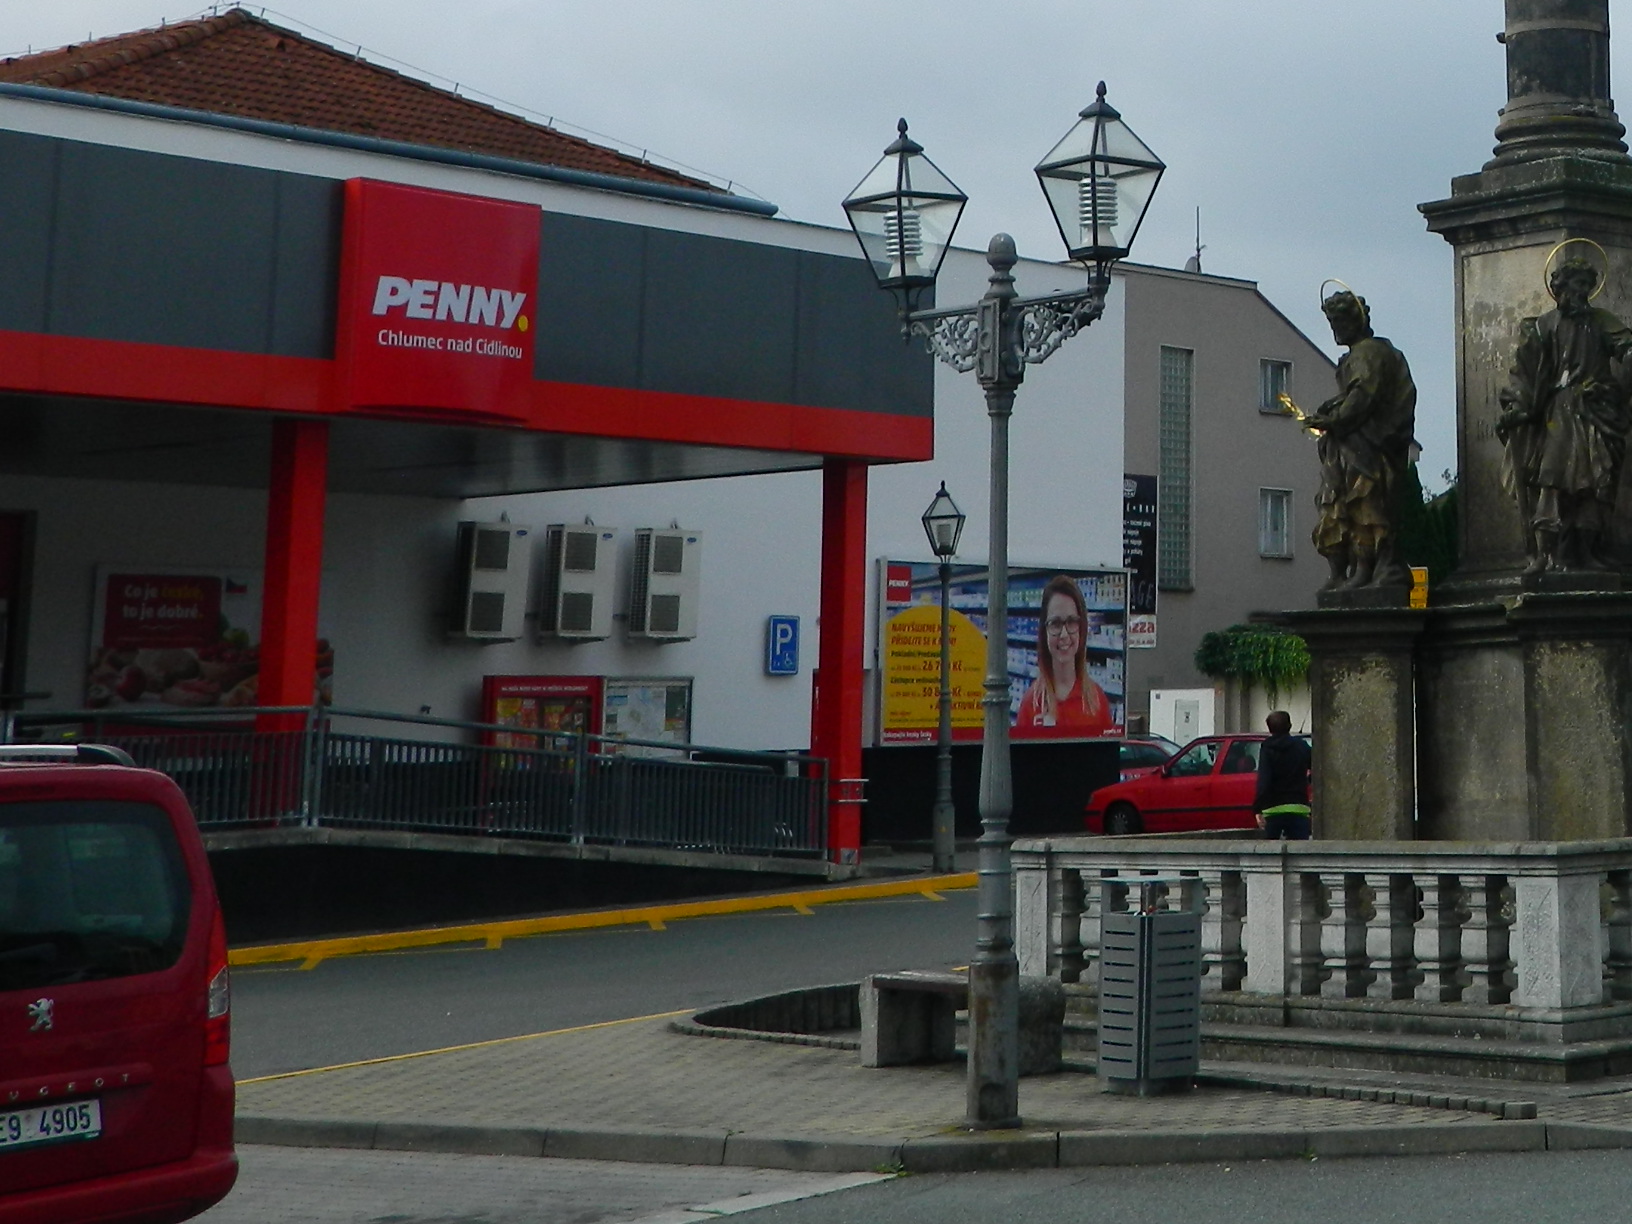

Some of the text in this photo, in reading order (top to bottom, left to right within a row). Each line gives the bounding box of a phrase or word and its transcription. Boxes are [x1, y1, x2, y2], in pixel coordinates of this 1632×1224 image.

[378, 329, 522, 359] Chlumec nad Cidlinou
[144, 582, 159, 600] je
[123, 605, 138, 618] to
[140, 603, 154, 620] je
[776, 623, 793, 655] P
[39, 1104, 91, 1135] 4905
